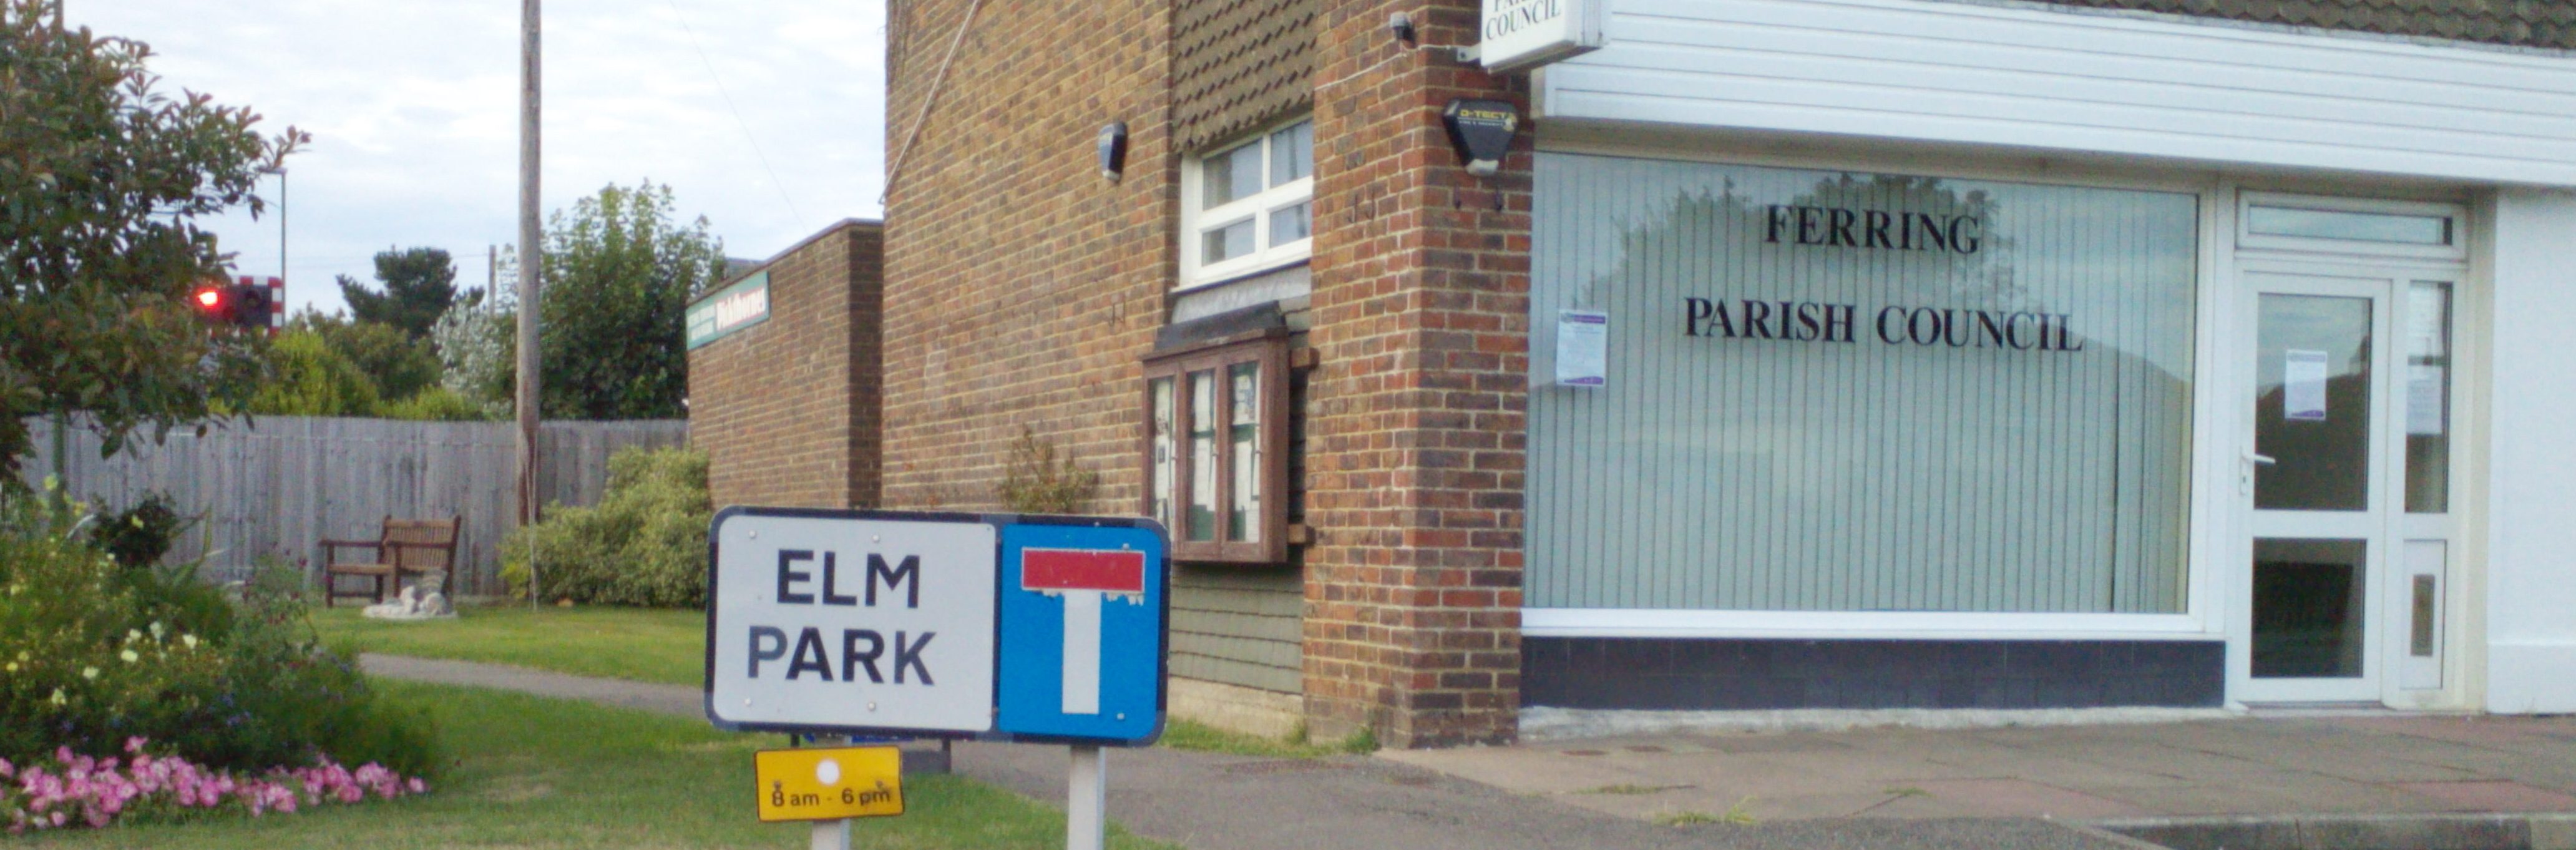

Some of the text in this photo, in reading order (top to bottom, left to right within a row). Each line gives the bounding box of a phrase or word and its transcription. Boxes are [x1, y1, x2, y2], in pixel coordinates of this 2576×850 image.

[1486, 0, 1561, 40] COUNCIL
[1765, 203, 1981, 255] FERRING
[1685, 296, 2084, 351] PARISH COUNCIL
[776, 549, 920, 609] ELM
[747, 625, 936, 686] PARK
[772, 789, 784, 807] 8
[790, 793, 820, 806] am
[842, 788, 854, 804] 6
[859, 789, 890, 807] pm
